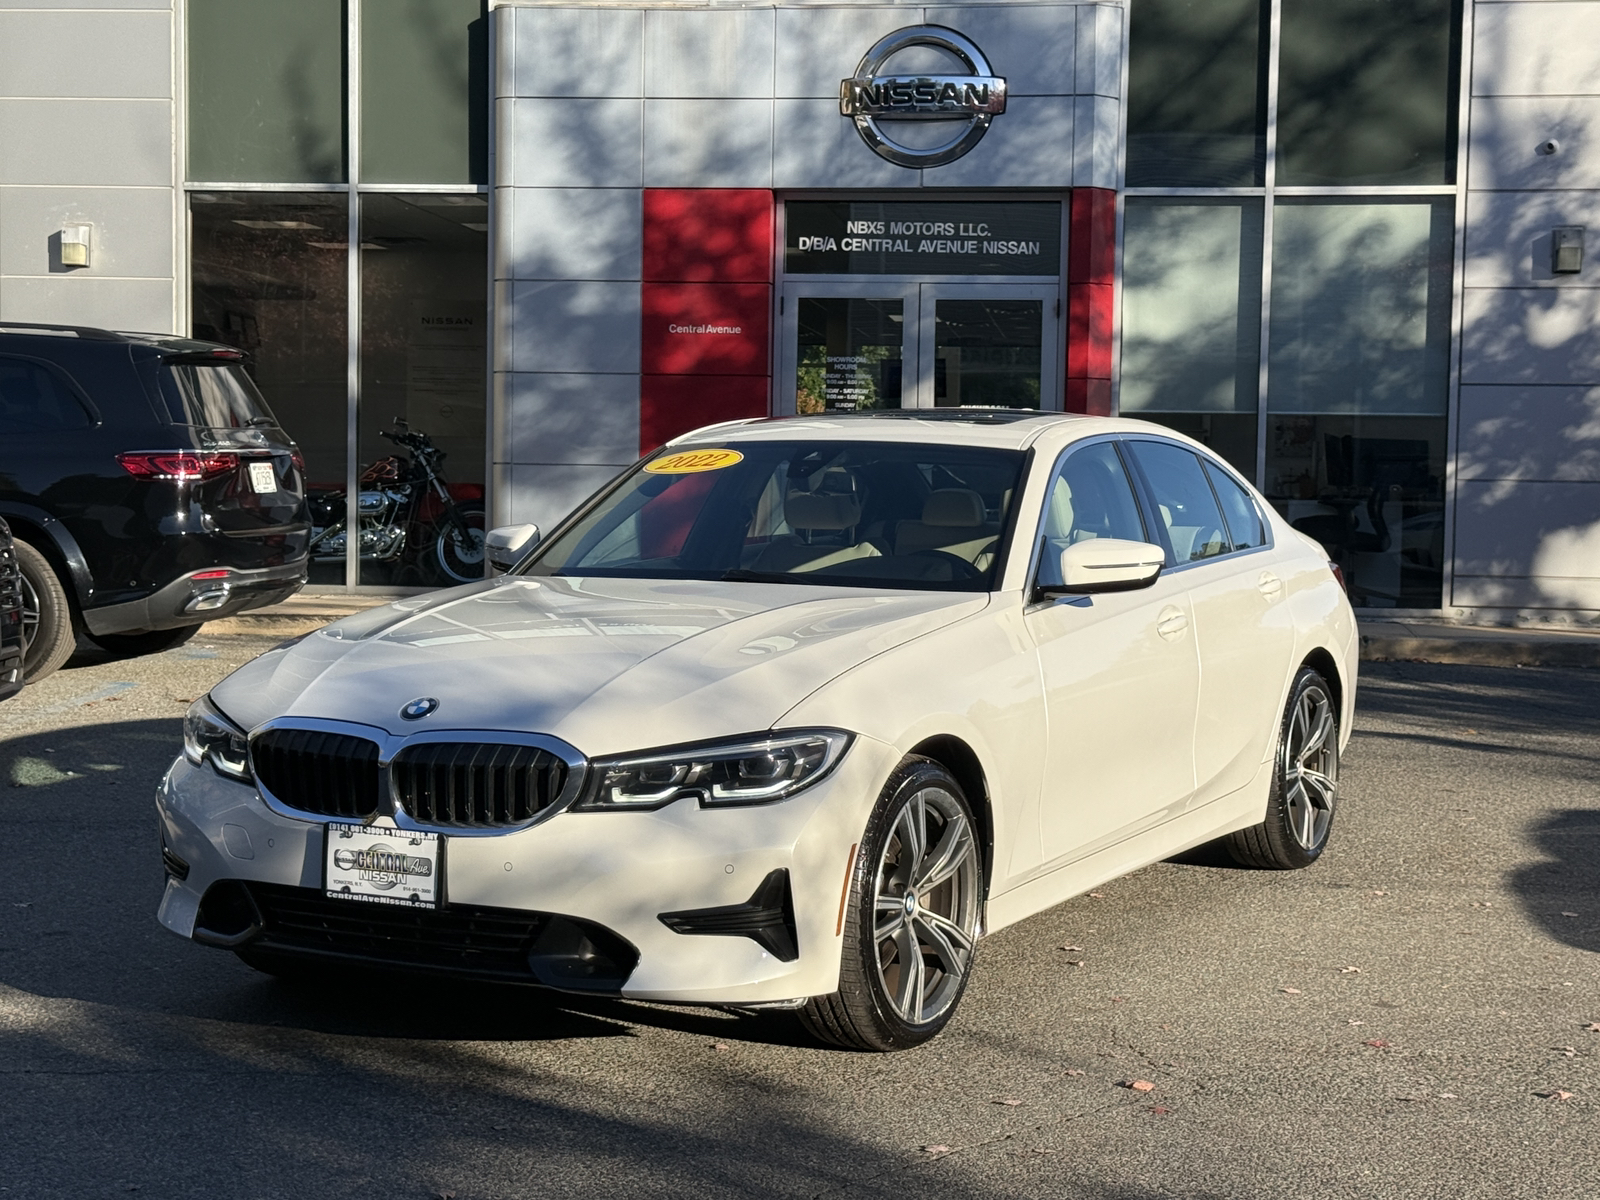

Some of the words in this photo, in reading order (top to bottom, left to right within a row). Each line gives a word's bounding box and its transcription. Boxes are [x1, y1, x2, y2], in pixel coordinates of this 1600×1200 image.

[855, 82, 990, 107] NISSAN
[846, 220, 885, 235] NBX5
[890, 222, 955, 236] MOTORS
[959, 223, 992, 237] LLC.
[798, 236, 838, 252] D/B/A
[841, 237, 914, 253] CENTRAL
[918, 239, 978, 254] AVENUE
[982, 241, 1040, 255] NISSAN
[421, 317, 474, 326] NISSAN
[668, 323, 705, 334] Central
[706, 324, 742, 334] Avenue
[655, 453, 731, 470] 2022
[356, 850, 408, 873] CENTRAL
[359, 869, 407, 885] NISSAN
[326, 891, 436, 910] CentralAveNissan.com
